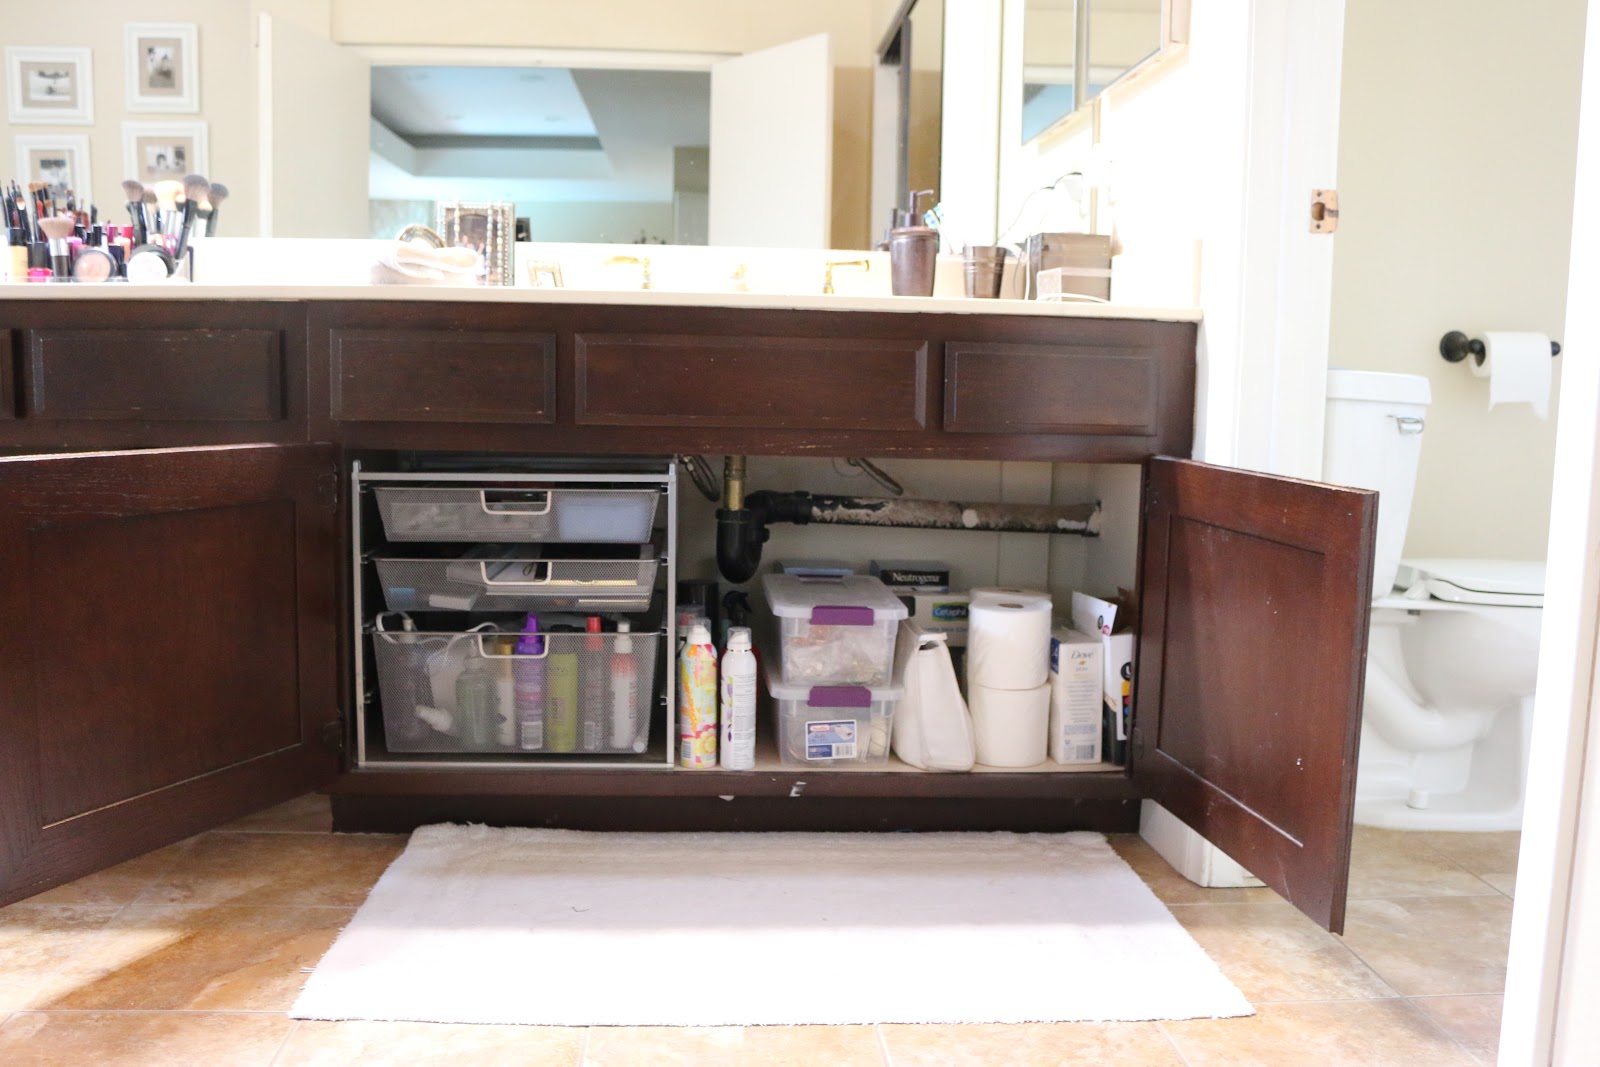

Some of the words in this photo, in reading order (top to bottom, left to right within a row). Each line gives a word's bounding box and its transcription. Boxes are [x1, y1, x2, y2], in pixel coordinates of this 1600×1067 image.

[892, 572, 940, 584] Neutrogena
[934, 607, 967, 618] Cetaphil
[1071, 650, 1094, 660] Dove
